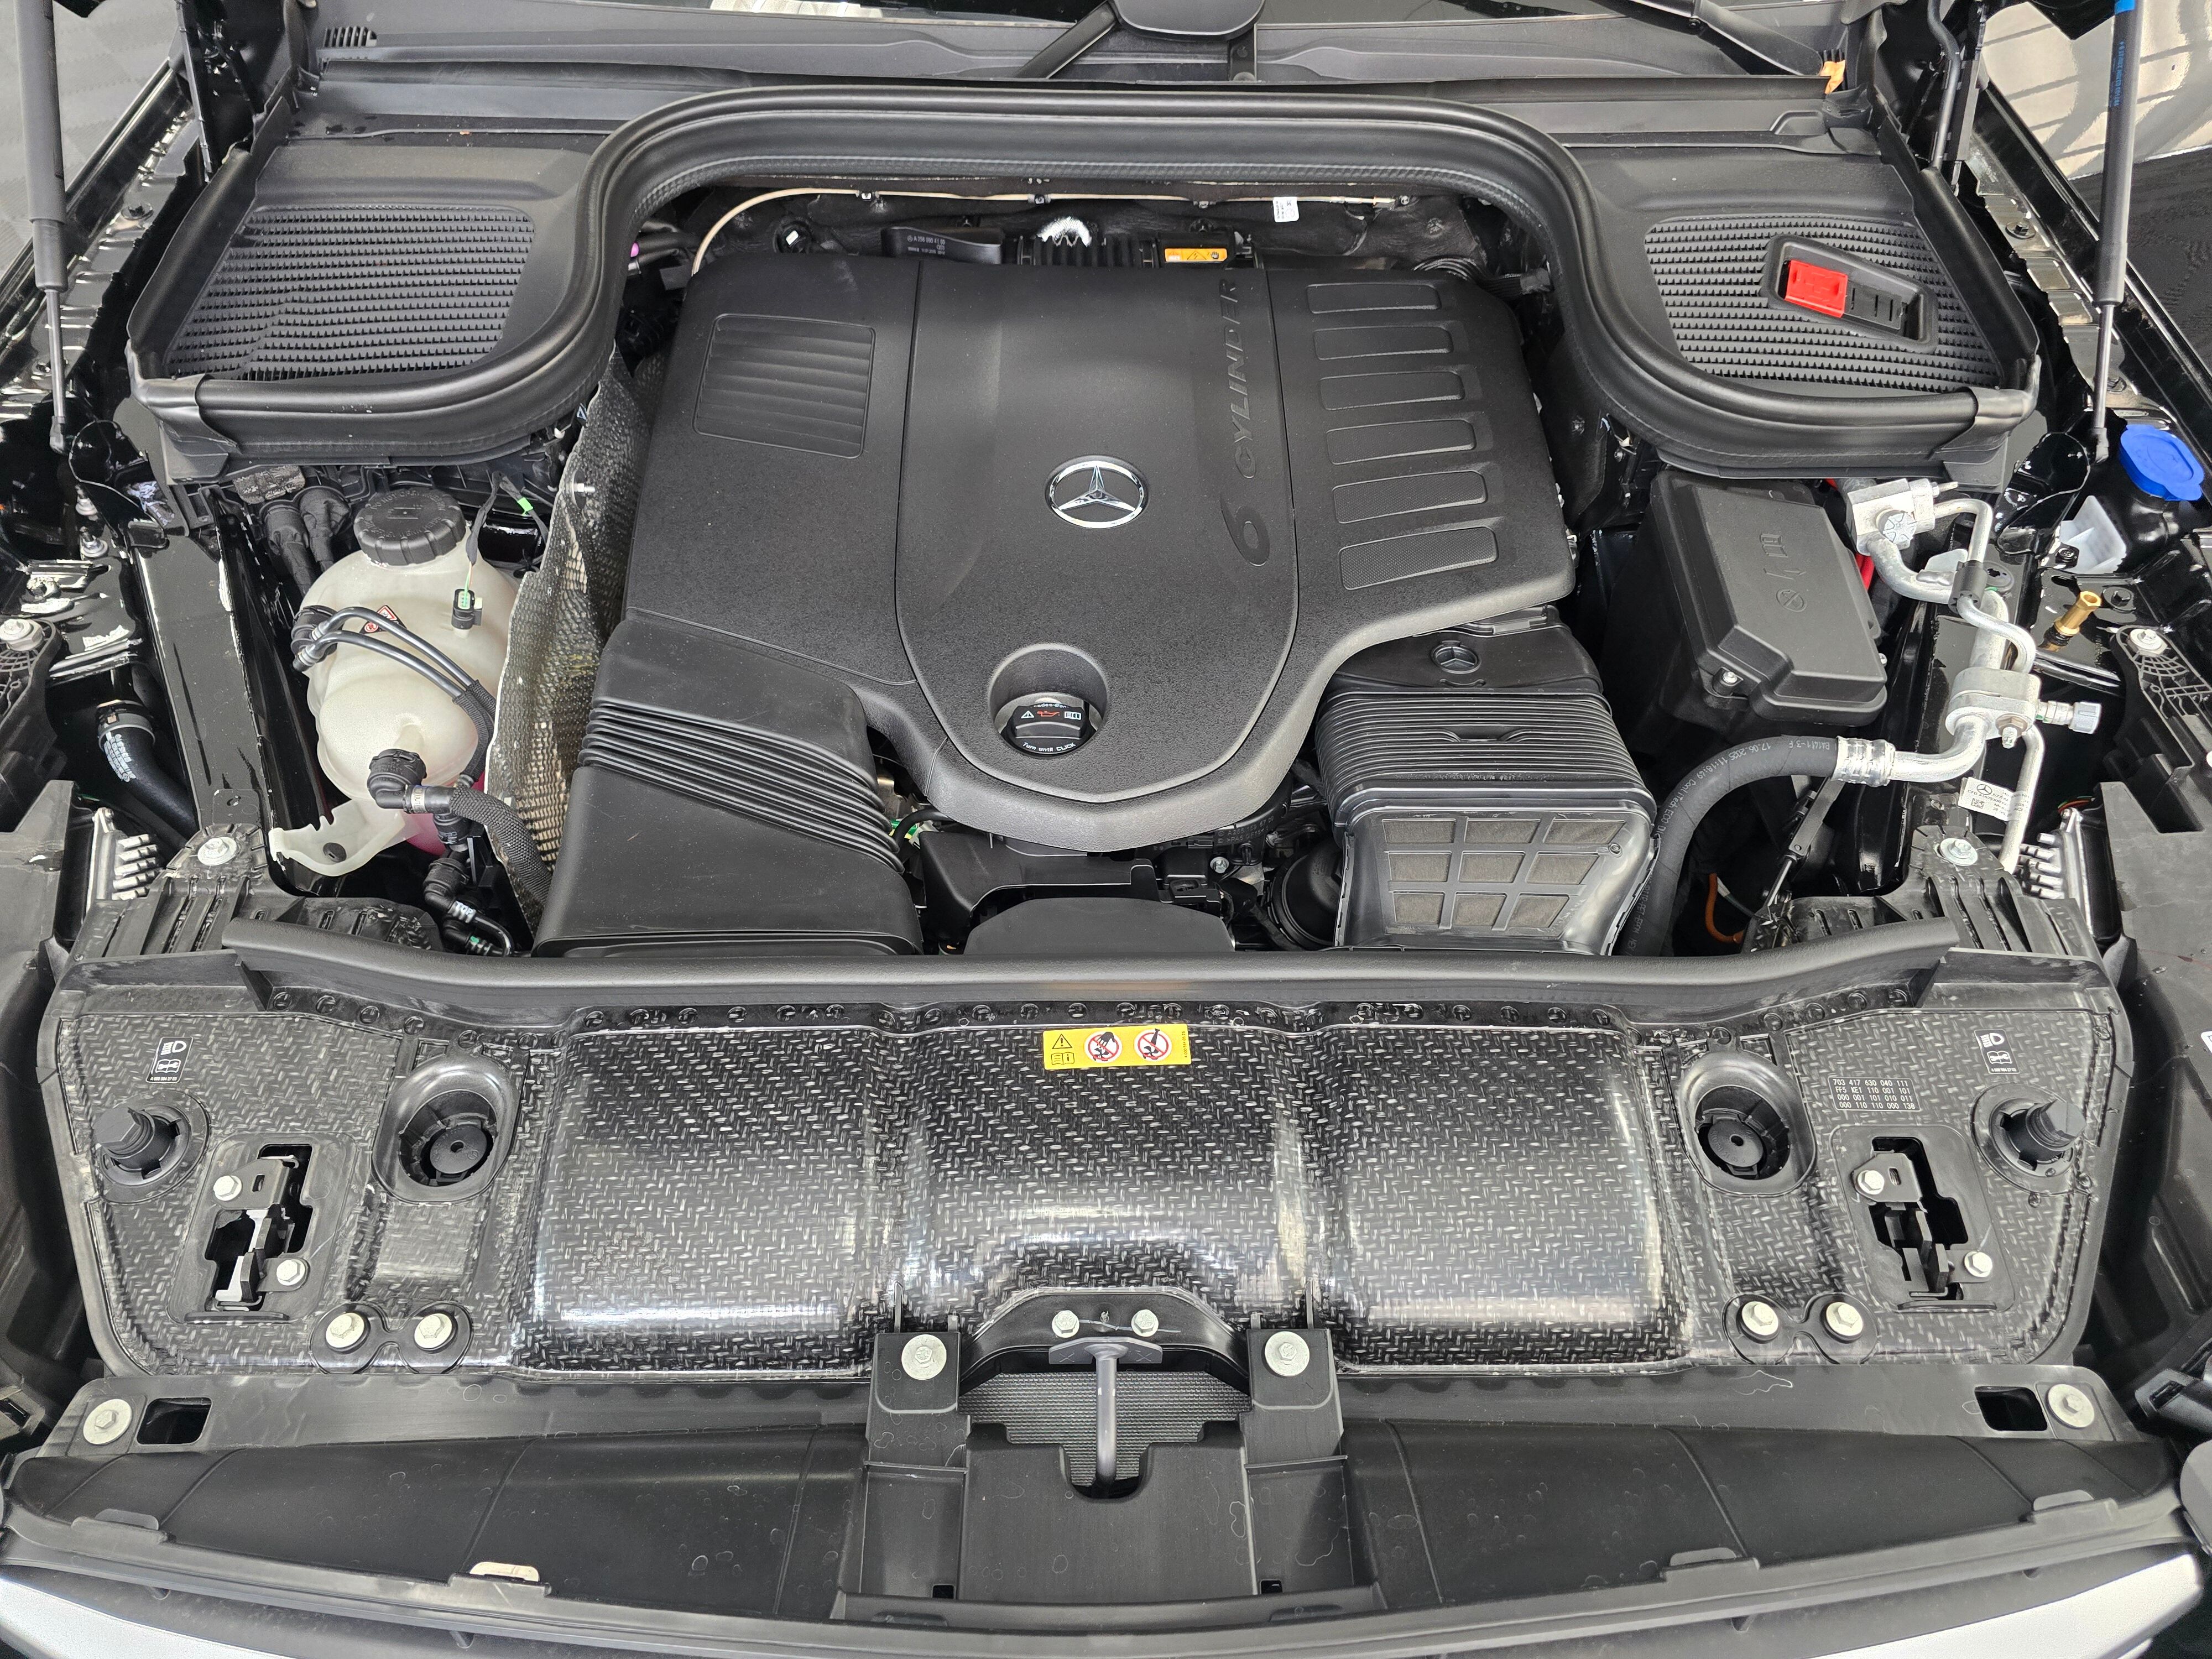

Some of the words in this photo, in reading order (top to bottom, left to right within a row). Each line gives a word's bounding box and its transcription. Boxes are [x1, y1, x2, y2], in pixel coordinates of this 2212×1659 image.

[1218, 278, 1257, 480] CYLINDER
[1220, 495, 1271, 567] 6
[1022, 742, 1037, 751] Turn
[1056, 742, 1076, 752] CLICK
[1728, 742, 1772, 761] 17.06.2025
[455, 901, 474, 915] TOP
